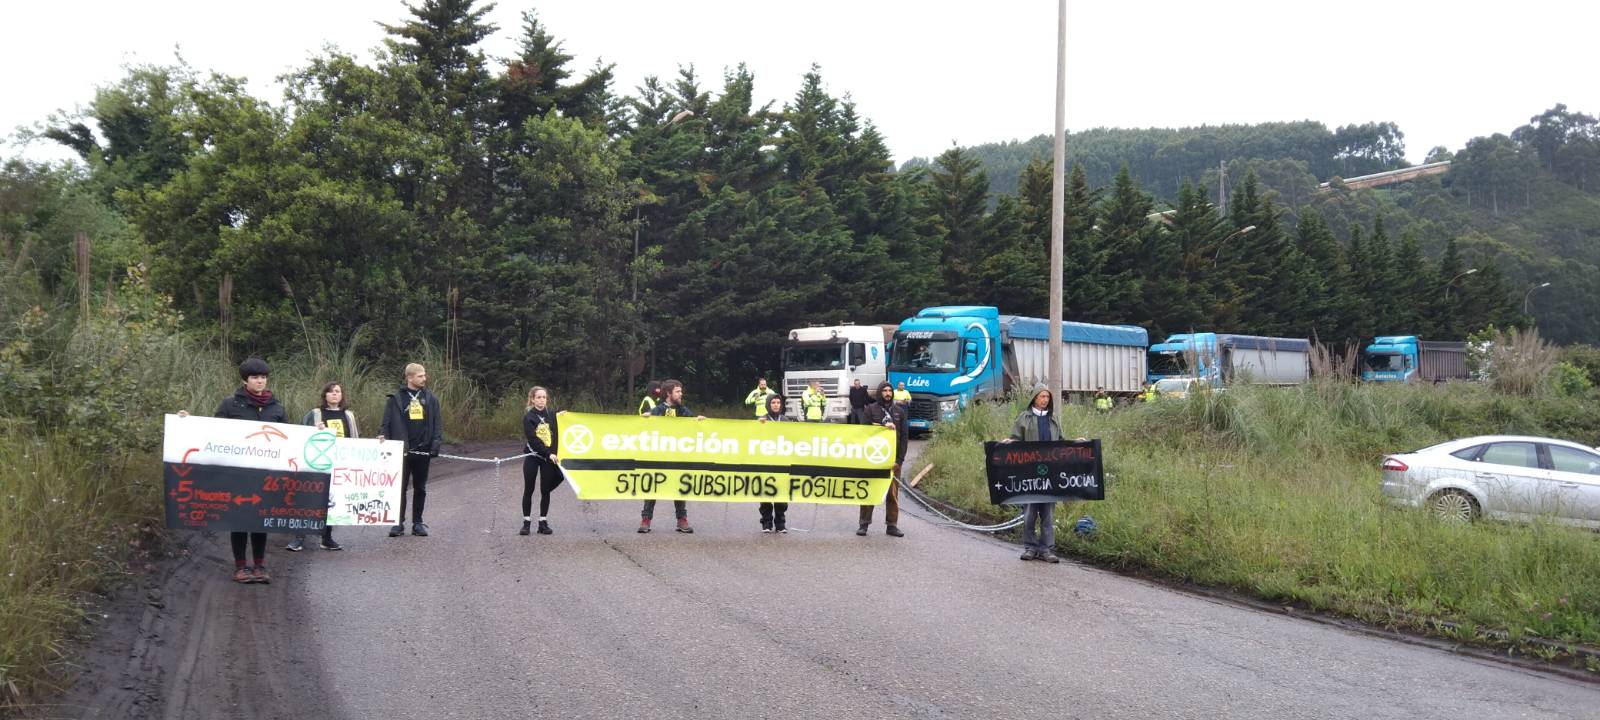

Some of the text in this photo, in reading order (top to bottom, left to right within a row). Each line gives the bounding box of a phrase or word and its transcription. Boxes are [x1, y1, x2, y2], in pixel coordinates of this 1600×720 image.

[907, 376, 930, 387] Leire
[204, 442, 281, 459] ArcelorMortal
[601, 431, 862, 459] extinción rebelión
[616, 472, 667, 496] STOP
[678, 473, 778, 497] SUBSIDIOS
[264, 518, 325, 530] DE TU BOLSILLO
